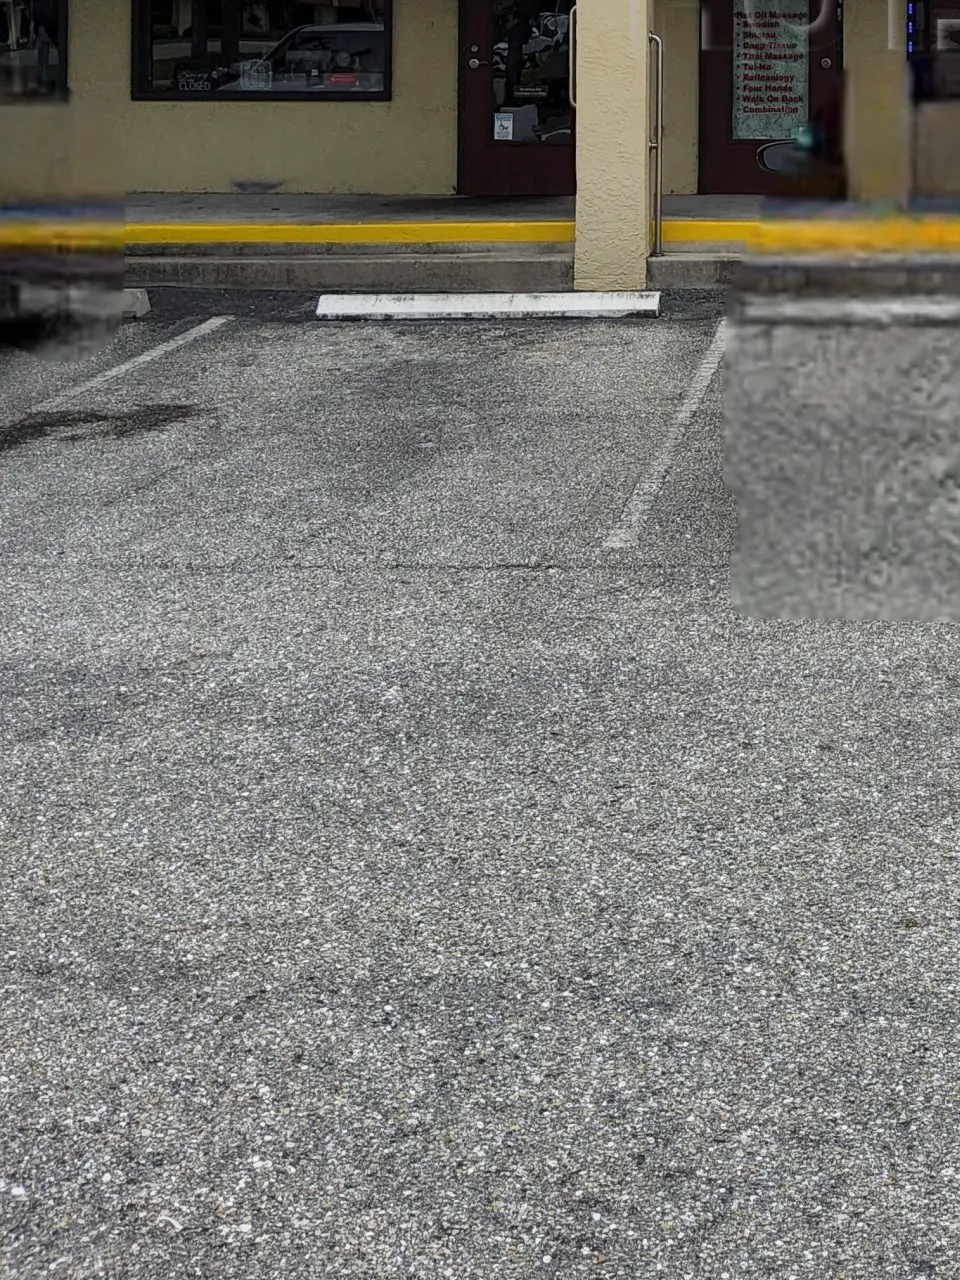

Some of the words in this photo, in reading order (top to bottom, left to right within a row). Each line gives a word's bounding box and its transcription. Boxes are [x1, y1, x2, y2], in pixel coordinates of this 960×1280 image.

[765, 52, 804, 62] Massage
[743, 73, 795, 83] Reflexology
[179, 81, 211, 90] CLOSED
[743, 84, 762, 92] Four
[765, 84, 793, 92] Hands
[743, 95, 764, 103] Walk
[781, 95, 804, 103] Back
[743, 105, 799, 113] Combination
